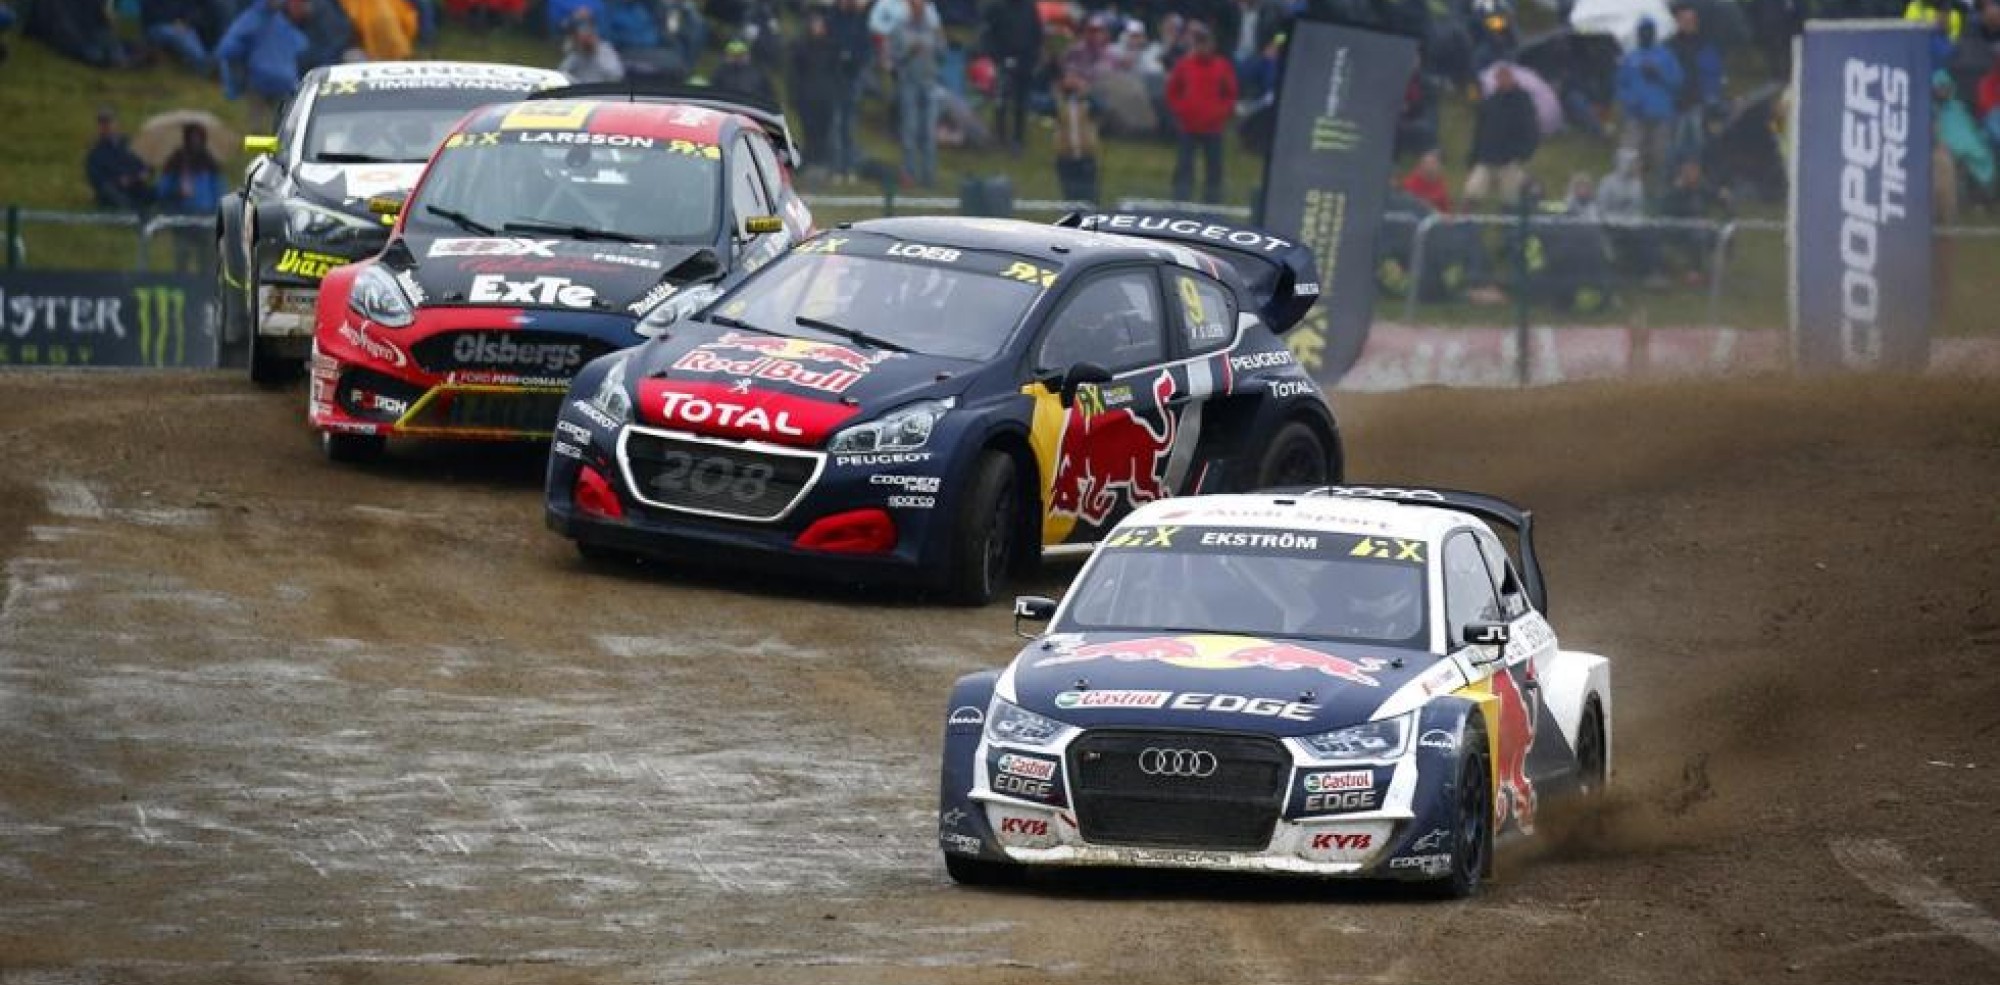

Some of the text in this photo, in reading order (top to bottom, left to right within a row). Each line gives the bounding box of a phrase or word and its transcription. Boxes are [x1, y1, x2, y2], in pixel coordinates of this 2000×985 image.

[520, 131, 653, 148] LARSSON
[1880, 65, 1909, 225] TIRES
[1841, 57, 1881, 366] COOPER
[1079, 212, 1291, 251] PEUGEOT
[886, 242, 963, 262] LOEB
[469, 273, 597, 307] ExTe
[0, 287, 126, 338] STER
[453, 332, 582, 370] Olsbergs
[491, 373, 573, 387] PERFORMANC
[672, 349, 866, 393] Red Bull
[660, 391, 804, 436] TOTAL
[836, 452, 932, 466] PEUGEOT
[651, 451, 775, 502] 208
[1201, 531, 1319, 550] EKSTRÖM
[1082, 691, 1323, 722] Castrol EDGE
[1010, 755, 1052, 779] Castrol
[995, 774, 1053, 797] EDGE
[1322, 772, 1371, 789] Castrol
[1306, 790, 1377, 811] EDGE
[1001, 817, 1047, 836] KYB
[1312, 834, 1372, 850] KYB
